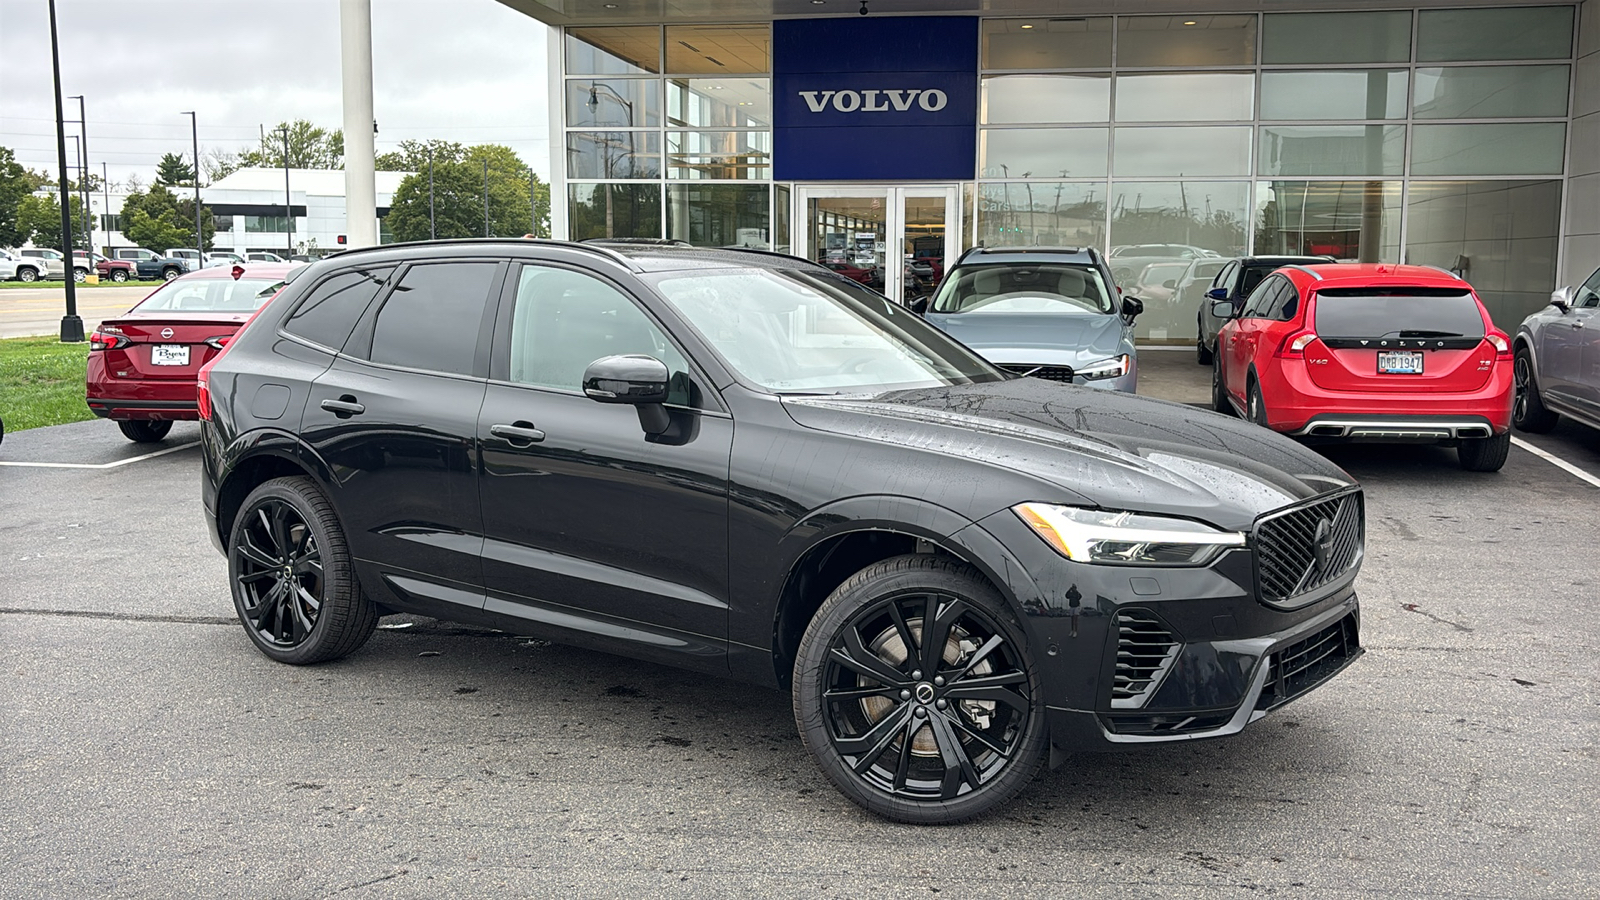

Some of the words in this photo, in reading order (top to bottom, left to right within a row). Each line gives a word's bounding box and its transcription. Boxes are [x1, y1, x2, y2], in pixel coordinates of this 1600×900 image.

[799, 89, 947, 112] VOLVO
[980, 200, 1010, 212] Cars
[1399, 356, 1421, 369] 1947
